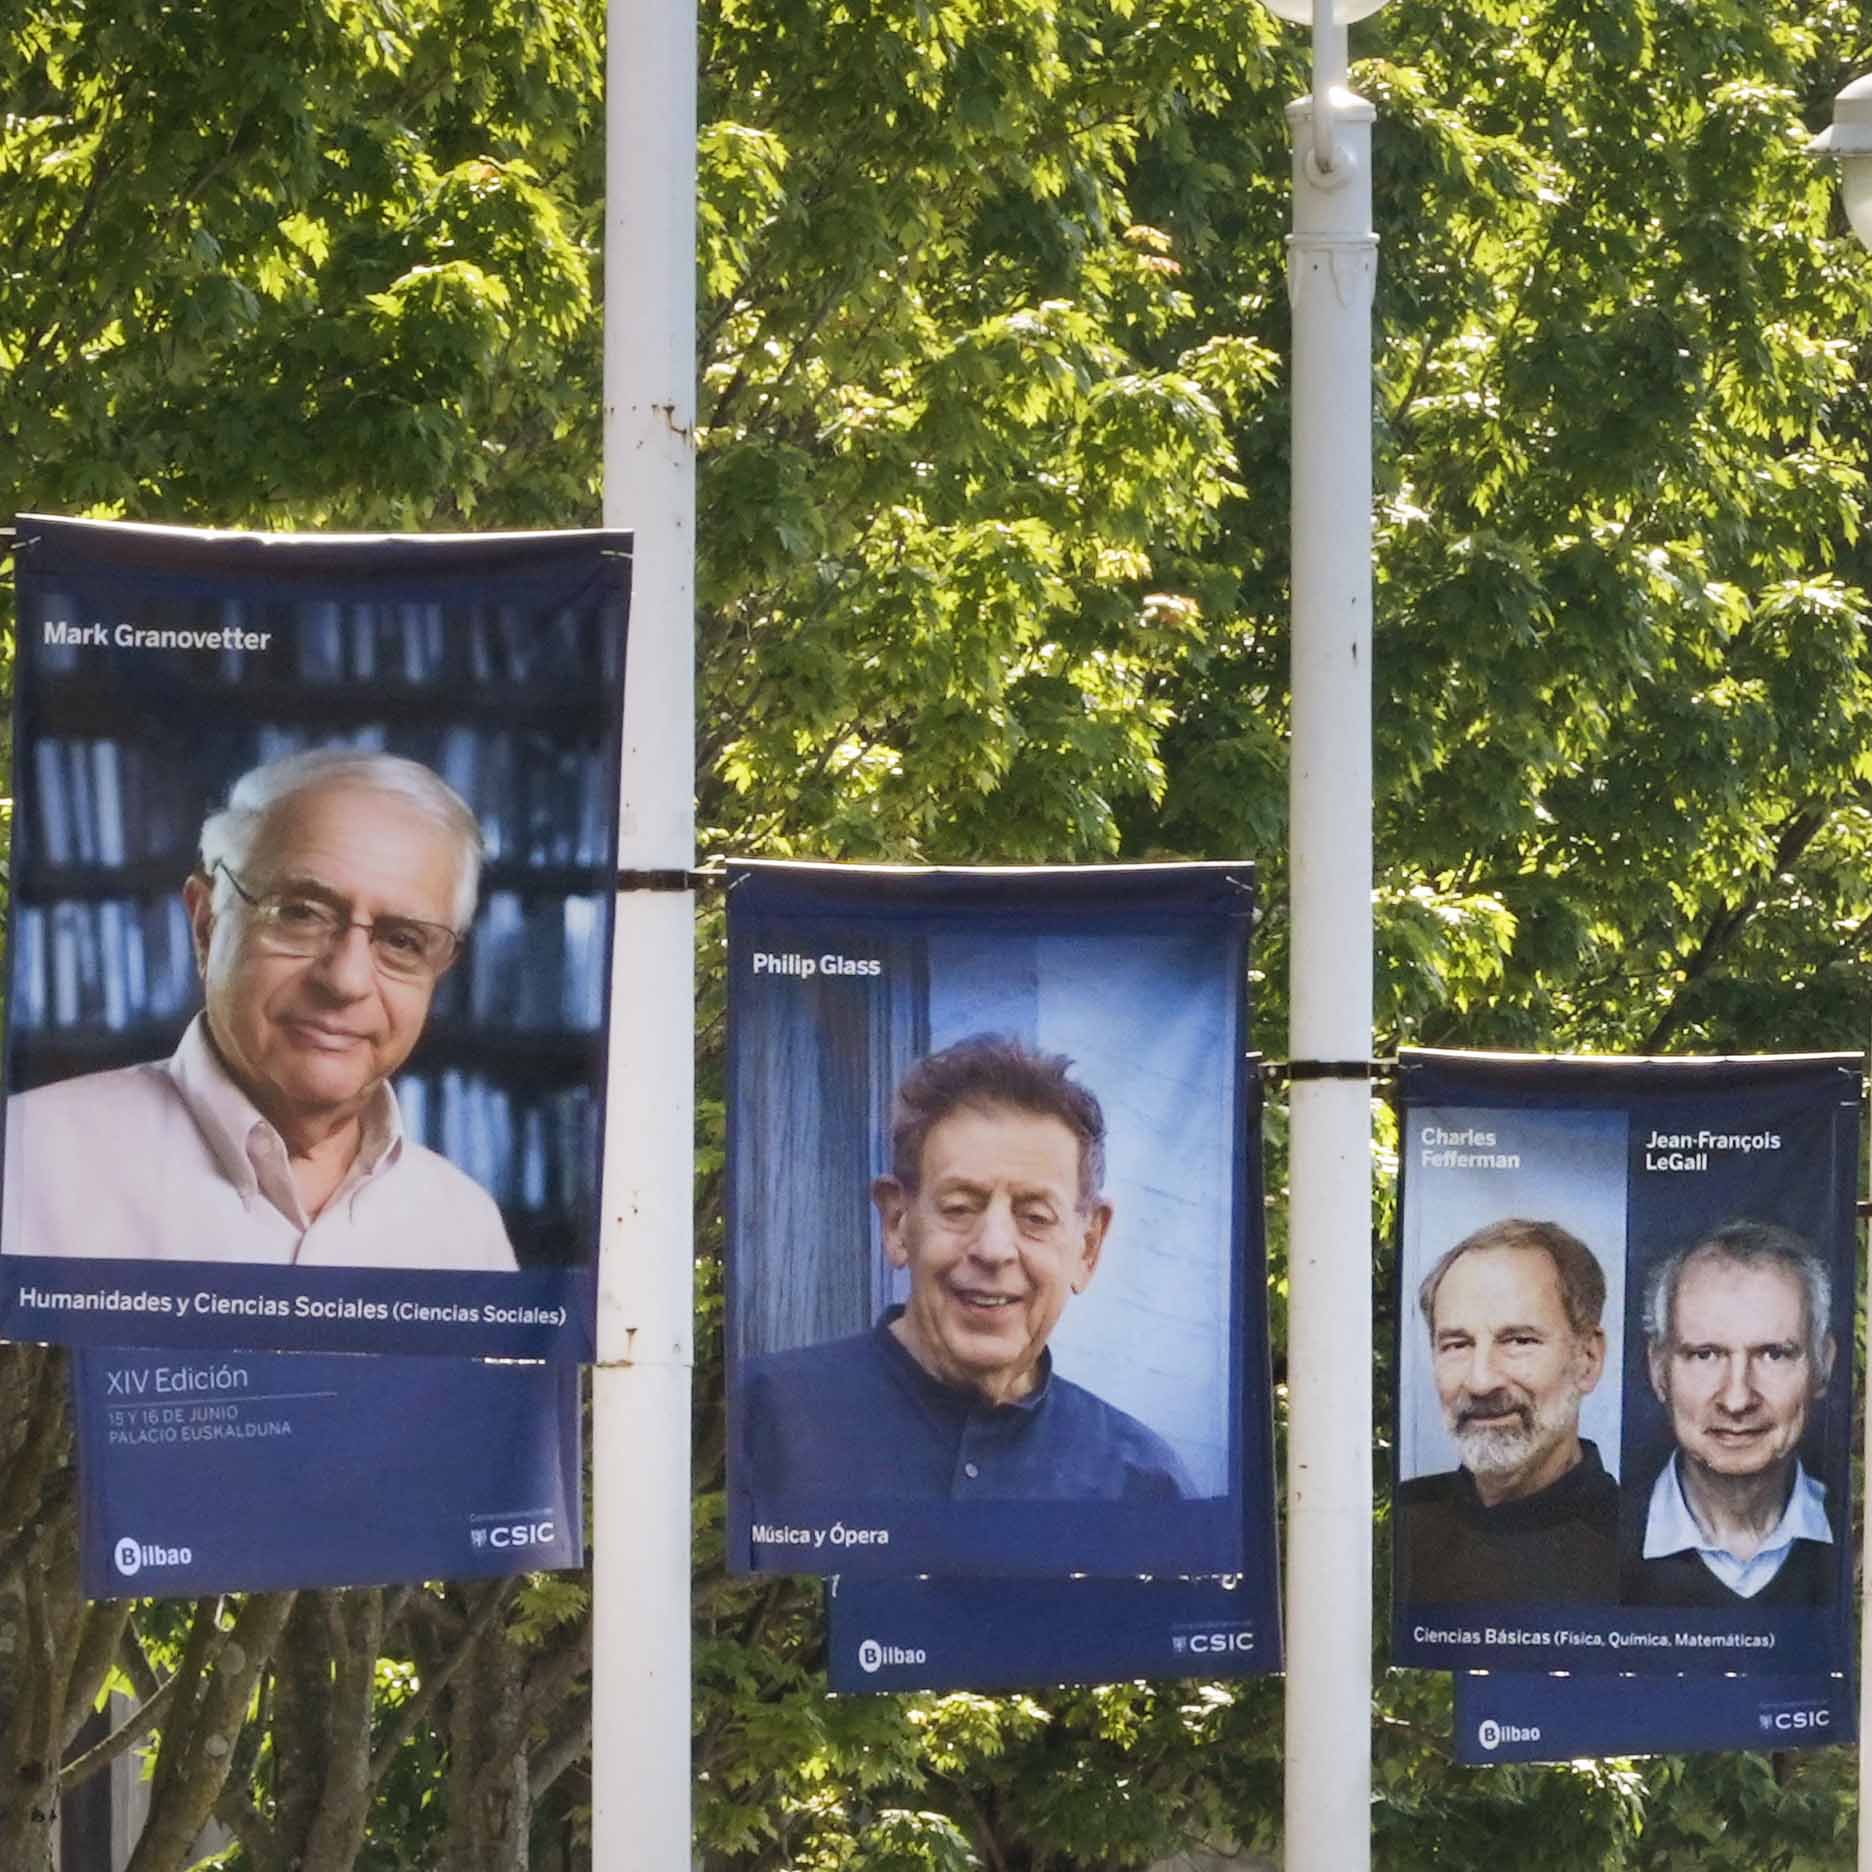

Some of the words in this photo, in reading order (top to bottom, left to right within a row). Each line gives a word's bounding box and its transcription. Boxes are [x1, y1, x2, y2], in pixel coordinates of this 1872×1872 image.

[45, 622, 108, 645] Mark
[115, 624, 271, 650] Granovetter
[754, 953, 816, 978] Philip
[820, 955, 880, 975] Glass
[1422, 1128, 1496, 1146] Charles
[1646, 1131, 1780, 1152] Jean-François
[1422, 1150, 1520, 1168] Fefferman
[1647, 1153, 1707, 1170] LeGall
[20, 1288, 171, 1311] Humanidades
[177, 1298, 189, 1316] y
[195, 1293, 289, 1316] Ciencias
[295, 1296, 388, 1319] Sociales
[393, 1302, 479, 1322] (Ciencias
[483, 1305, 566, 1326] Sociales)
[108, 1370, 149, 1394] XIV
[156, 1365, 247, 1392] Edición
[109, 1412, 123, 1426] 15
[128, 1411, 137, 1424] Y
[143, 1409, 159, 1424] 16
[163, 1408, 184, 1423] DE
[190, 1406, 238, 1422] JUNIO
[110, 1427, 176, 1444] PALACIO
[178, 1418, 291, 1441] EUSKALDUNA
[491, 1522, 555, 1547] CSIC
[753, 1526, 810, 1543] Música
[815, 1530, 826, 1547] y
[830, 1522, 888, 1547] Ópera
[115, 1538, 191, 1575] Bilbao
[1190, 1633, 1253, 1652] CSIC
[1414, 1627, 1481, 1644] Ciencias
[1486, 1629, 1550, 1644] Básicas
[1554, 1631, 1604, 1646] (Física,
[1609, 1632, 1671, 1648] Química,
[1675, 1633, 1774, 1648] Matemáticas)
[859, 1640, 925, 1672] Bilbao
[1776, 1710, 1829, 1729] CSIC
[1479, 1720, 1540, 1749] Bilbao
